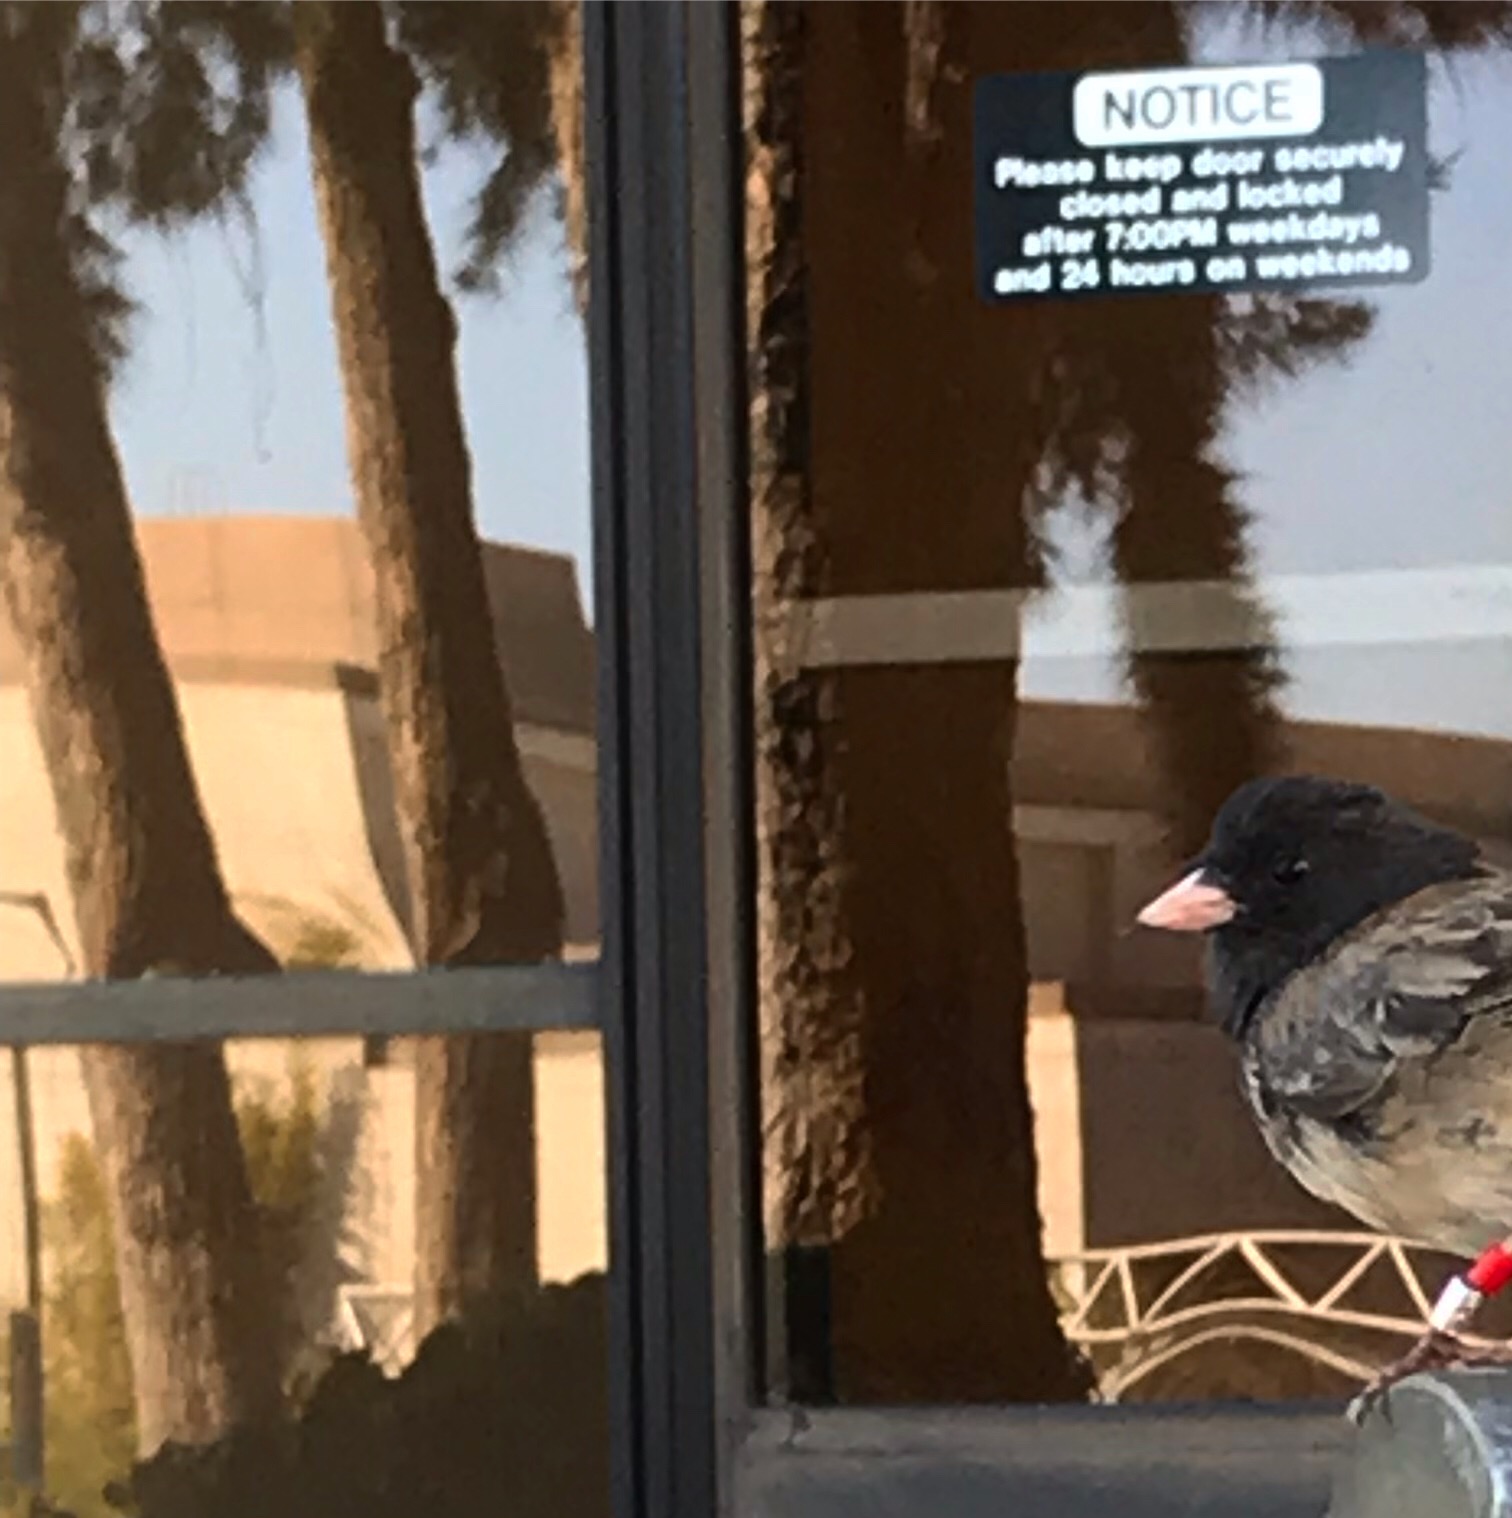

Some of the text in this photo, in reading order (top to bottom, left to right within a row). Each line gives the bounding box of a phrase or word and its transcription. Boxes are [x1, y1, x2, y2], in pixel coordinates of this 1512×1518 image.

[1103, 79, 1293, 131] NOTICE
[995, 136, 1404, 188] Please keep door securely
[1060, 174, 1343, 220] closed and locked
[1023, 211, 1380, 256] after 7:00PM weekdays
[995, 242, 1410, 294] and 24 hours on weekends
